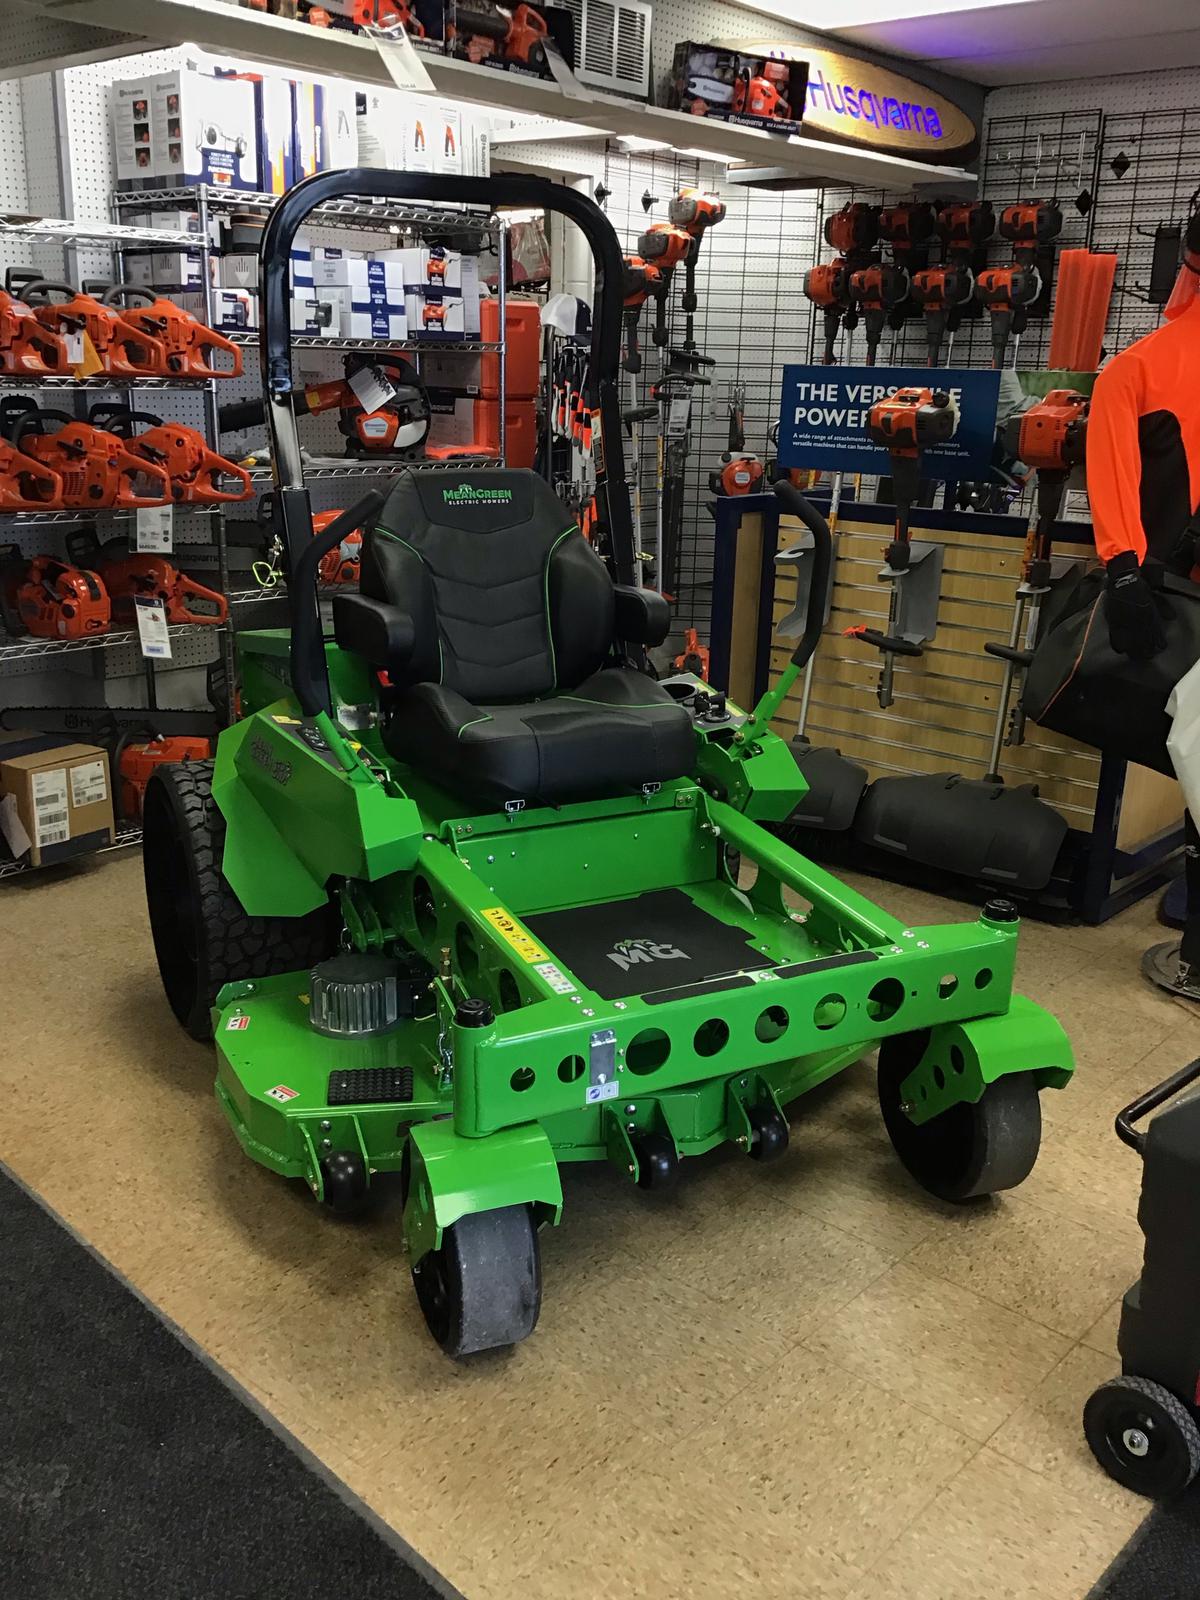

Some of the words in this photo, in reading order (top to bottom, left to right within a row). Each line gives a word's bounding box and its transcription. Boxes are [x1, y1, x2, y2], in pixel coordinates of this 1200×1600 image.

[807, 69, 944, 139] Husqvarna
[796, 383, 838, 402] THE
[845, 384, 962, 407] VERSE
[834, 435, 866, 443] attachments
[606, 944, 692, 971] MG
